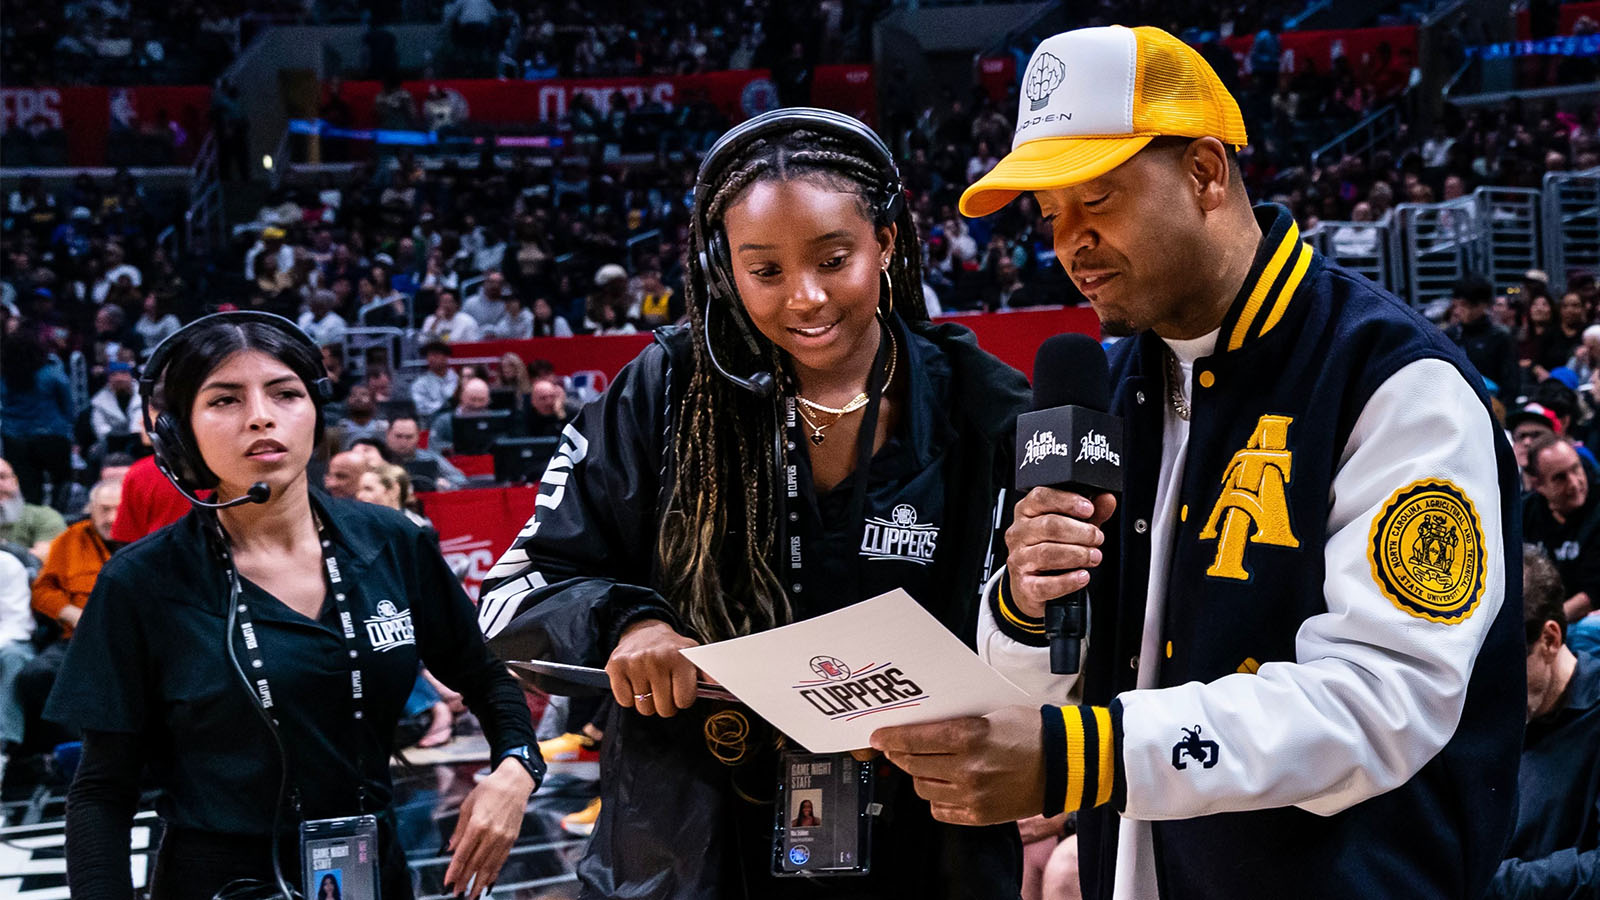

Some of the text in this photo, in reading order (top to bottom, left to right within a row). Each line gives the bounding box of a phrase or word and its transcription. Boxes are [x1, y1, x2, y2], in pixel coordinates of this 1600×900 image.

[1033, 429, 1053, 446] Los
[1075, 436, 1120, 467] Angeles
[1088, 429, 1107, 447] Los
[1019, 437, 1068, 470] Angeles
[1391, 503, 1423, 537] CAROLINA
[791, 536, 801, 563] CLIPPERS
[860, 523, 938, 559] CLIPPERS
[1463, 528, 1472, 544] AND
[1388, 540, 1401, 569] NORTH
[1459, 547, 1474, 589] TECHNICAL
[1400, 575, 1462, 602] STATE UNIVERSITY
[799, 667, 923, 716] CLIPPERS
[791, 776, 811, 789] STAFF
